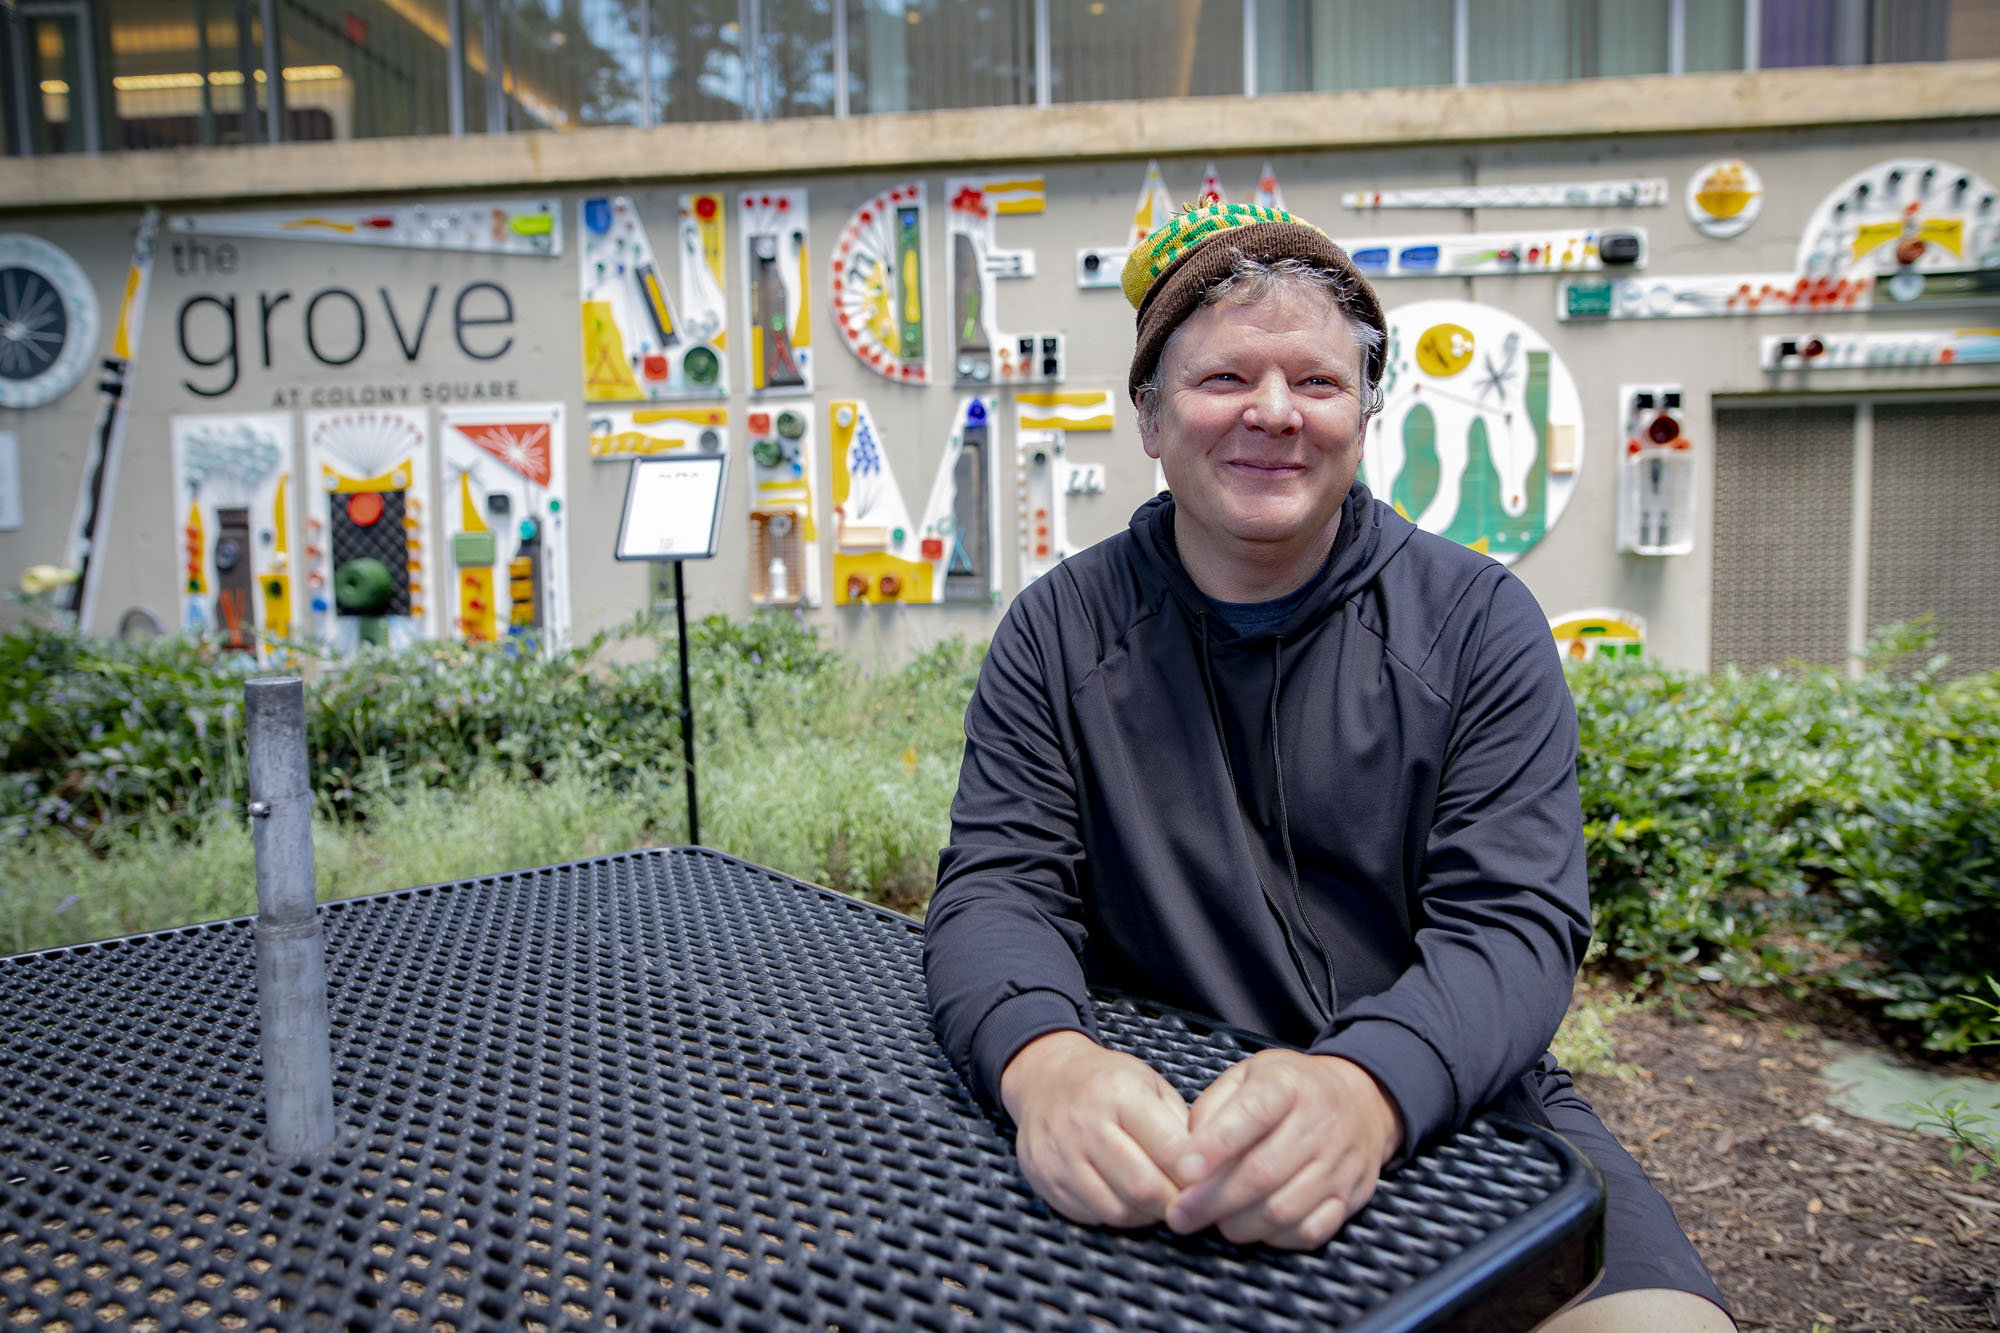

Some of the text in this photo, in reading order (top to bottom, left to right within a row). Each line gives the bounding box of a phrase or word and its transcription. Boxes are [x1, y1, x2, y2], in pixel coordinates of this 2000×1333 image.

[172, 238, 239, 276] the
[177, 281, 515, 396] grove
[271, 379, 520, 408] AT COLONY SQUARE
